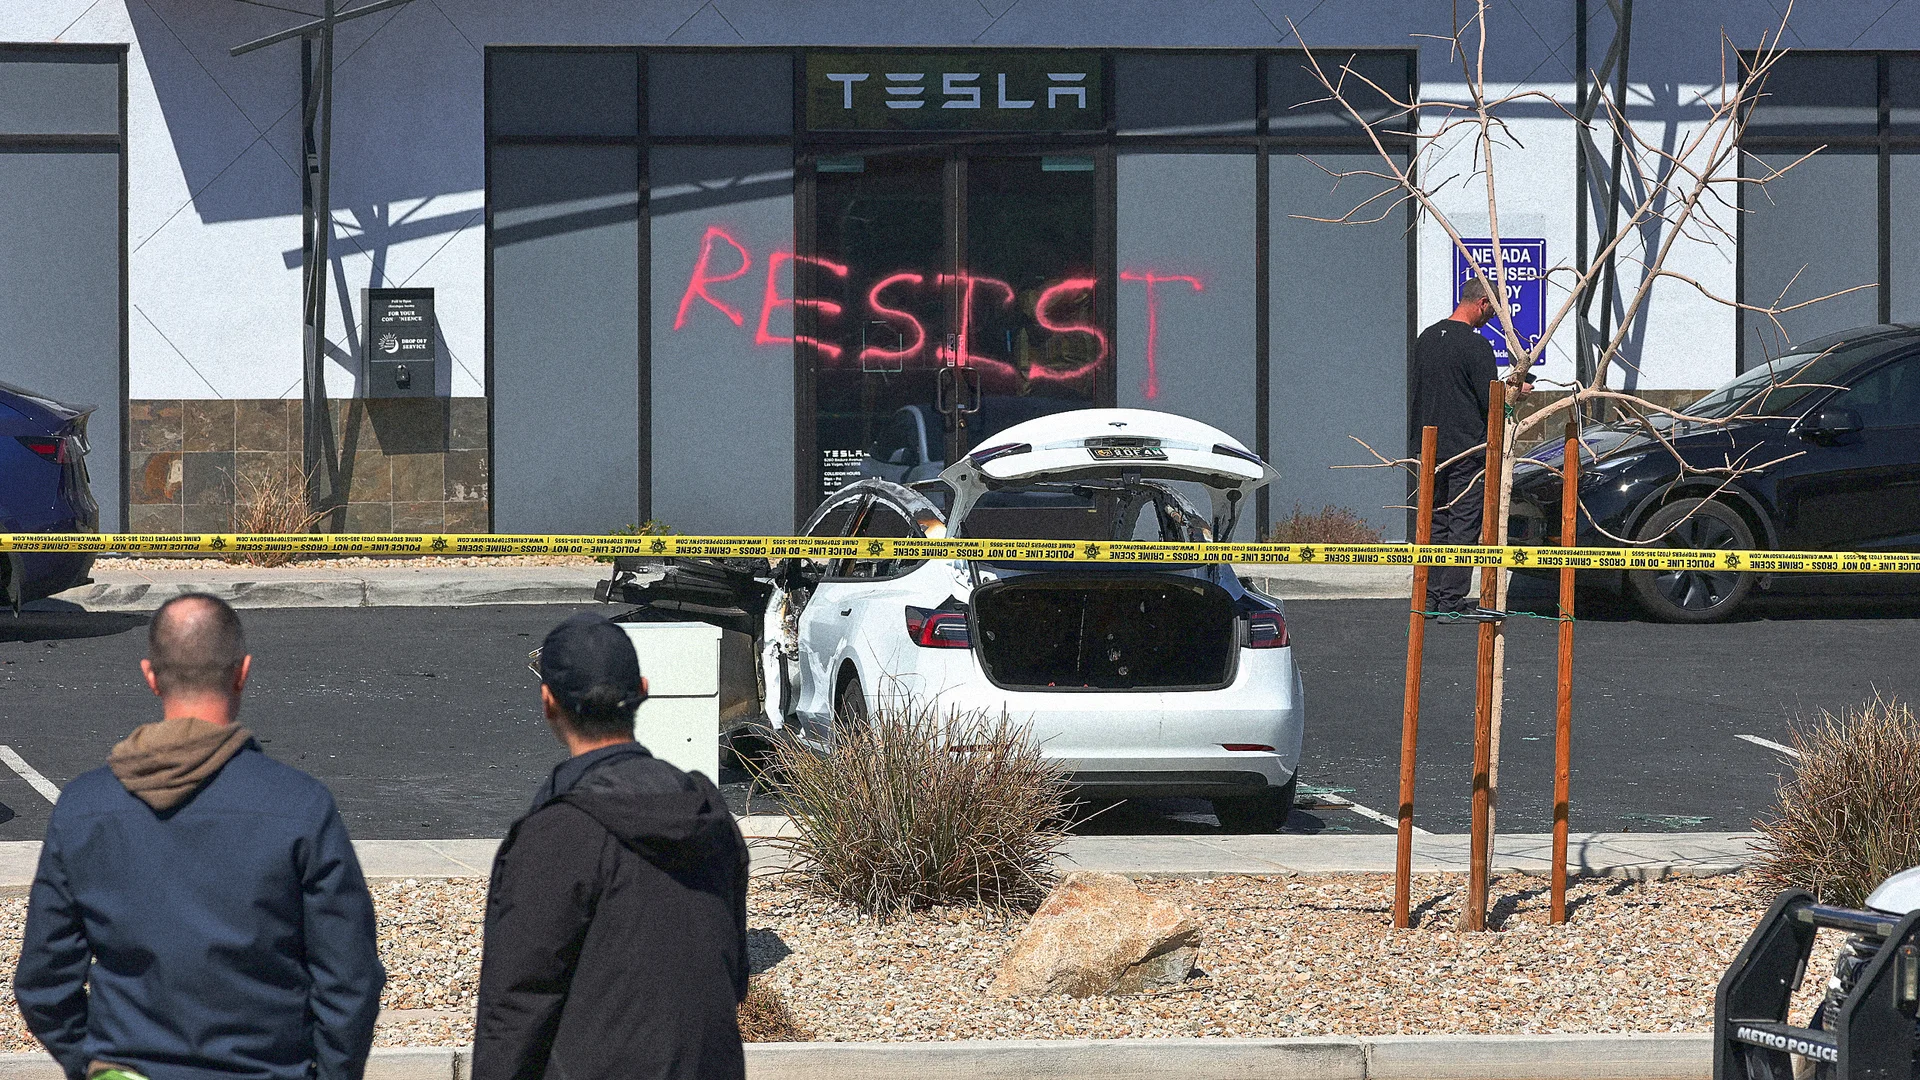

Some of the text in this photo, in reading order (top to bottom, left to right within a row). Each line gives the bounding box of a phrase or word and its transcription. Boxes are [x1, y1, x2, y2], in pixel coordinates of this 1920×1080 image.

[826, 73, 1086, 108] TESLA
[1466, 267, 1537, 281] LCESED
[672, 225, 1202, 399] RESIST
[893, 547, 919, 556] SCENE
[921, 548, 948, 556] CRIME
[956, 548, 983, 556] CROSS
[1138, 552, 1164, 560] CRIME
[1172, 552, 1199, 560] CROSS
[1260, 553, 1288, 561] POLICE
[1324, 554, 1350, 562] SCENE
[1352, 554, 1378, 562] CRIME
[1386, 554, 1412, 562] CROSS
[1416, 554, 1432, 562] NOT
[1474, 555, 1501, 563] POLICE
[1537, 556, 1562, 564] SCENE
[1599, 557, 1625, 566] CROSS
[1686, 559, 1714, 567] POLICE
[1750, 560, 1775, 568] SCENE
[1812, 561, 1837, 569] CROSS
[1842, 561, 1857, 569] NOT
[1898, 562, 1920, 570] OLICE
[1738, 1026, 1837, 1062] METRO POLICE
